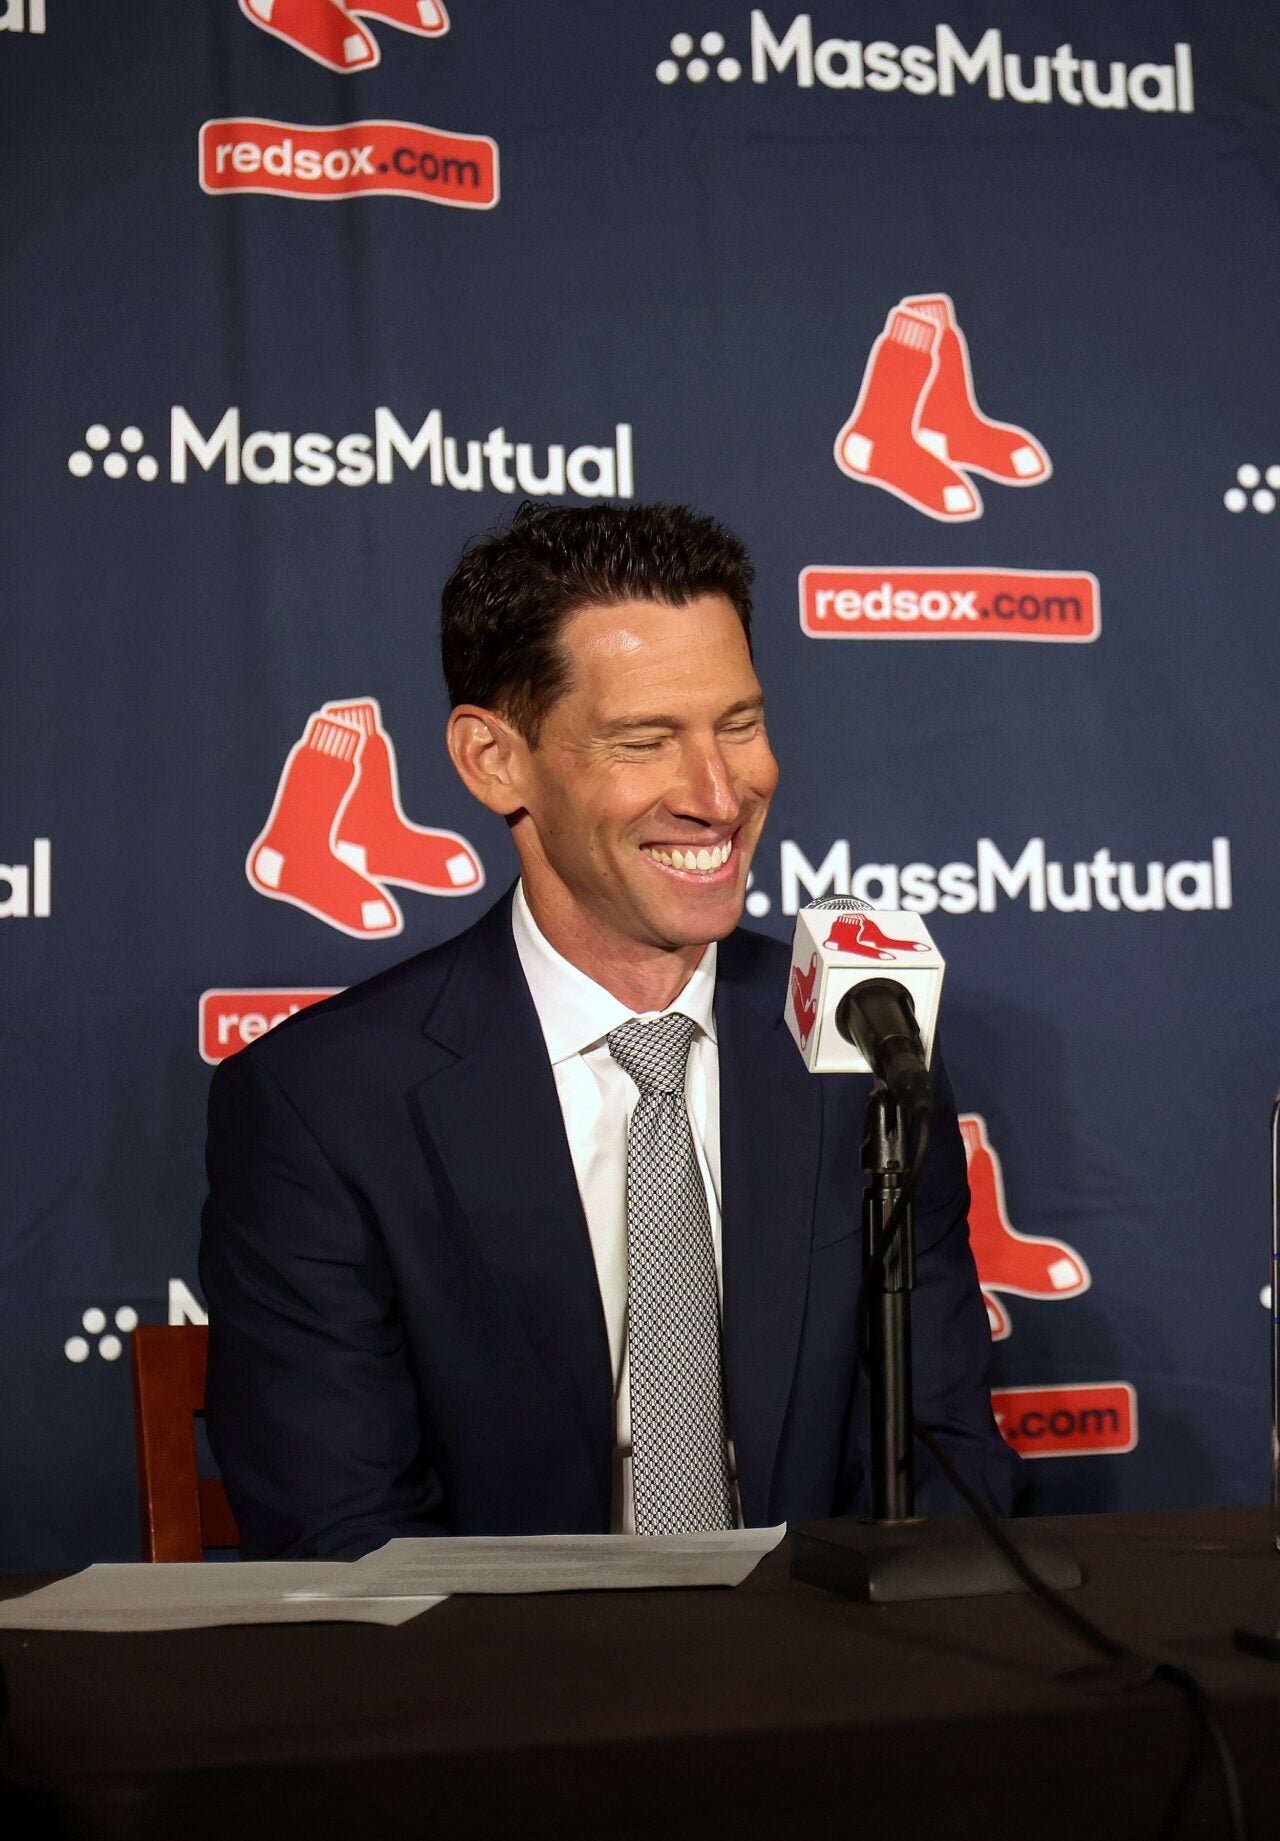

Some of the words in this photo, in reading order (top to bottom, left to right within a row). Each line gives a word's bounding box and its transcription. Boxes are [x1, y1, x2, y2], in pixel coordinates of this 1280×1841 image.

[750, 9, 1195, 114] MassMutual
[214, 137, 481, 188] redsox.com
[170, 406, 635, 498] MassMutual
[814, 581, 1082, 622] redsox.com
[780, 836, 1233, 915] MassMutual
[995, 1408, 1119, 1440] .com
